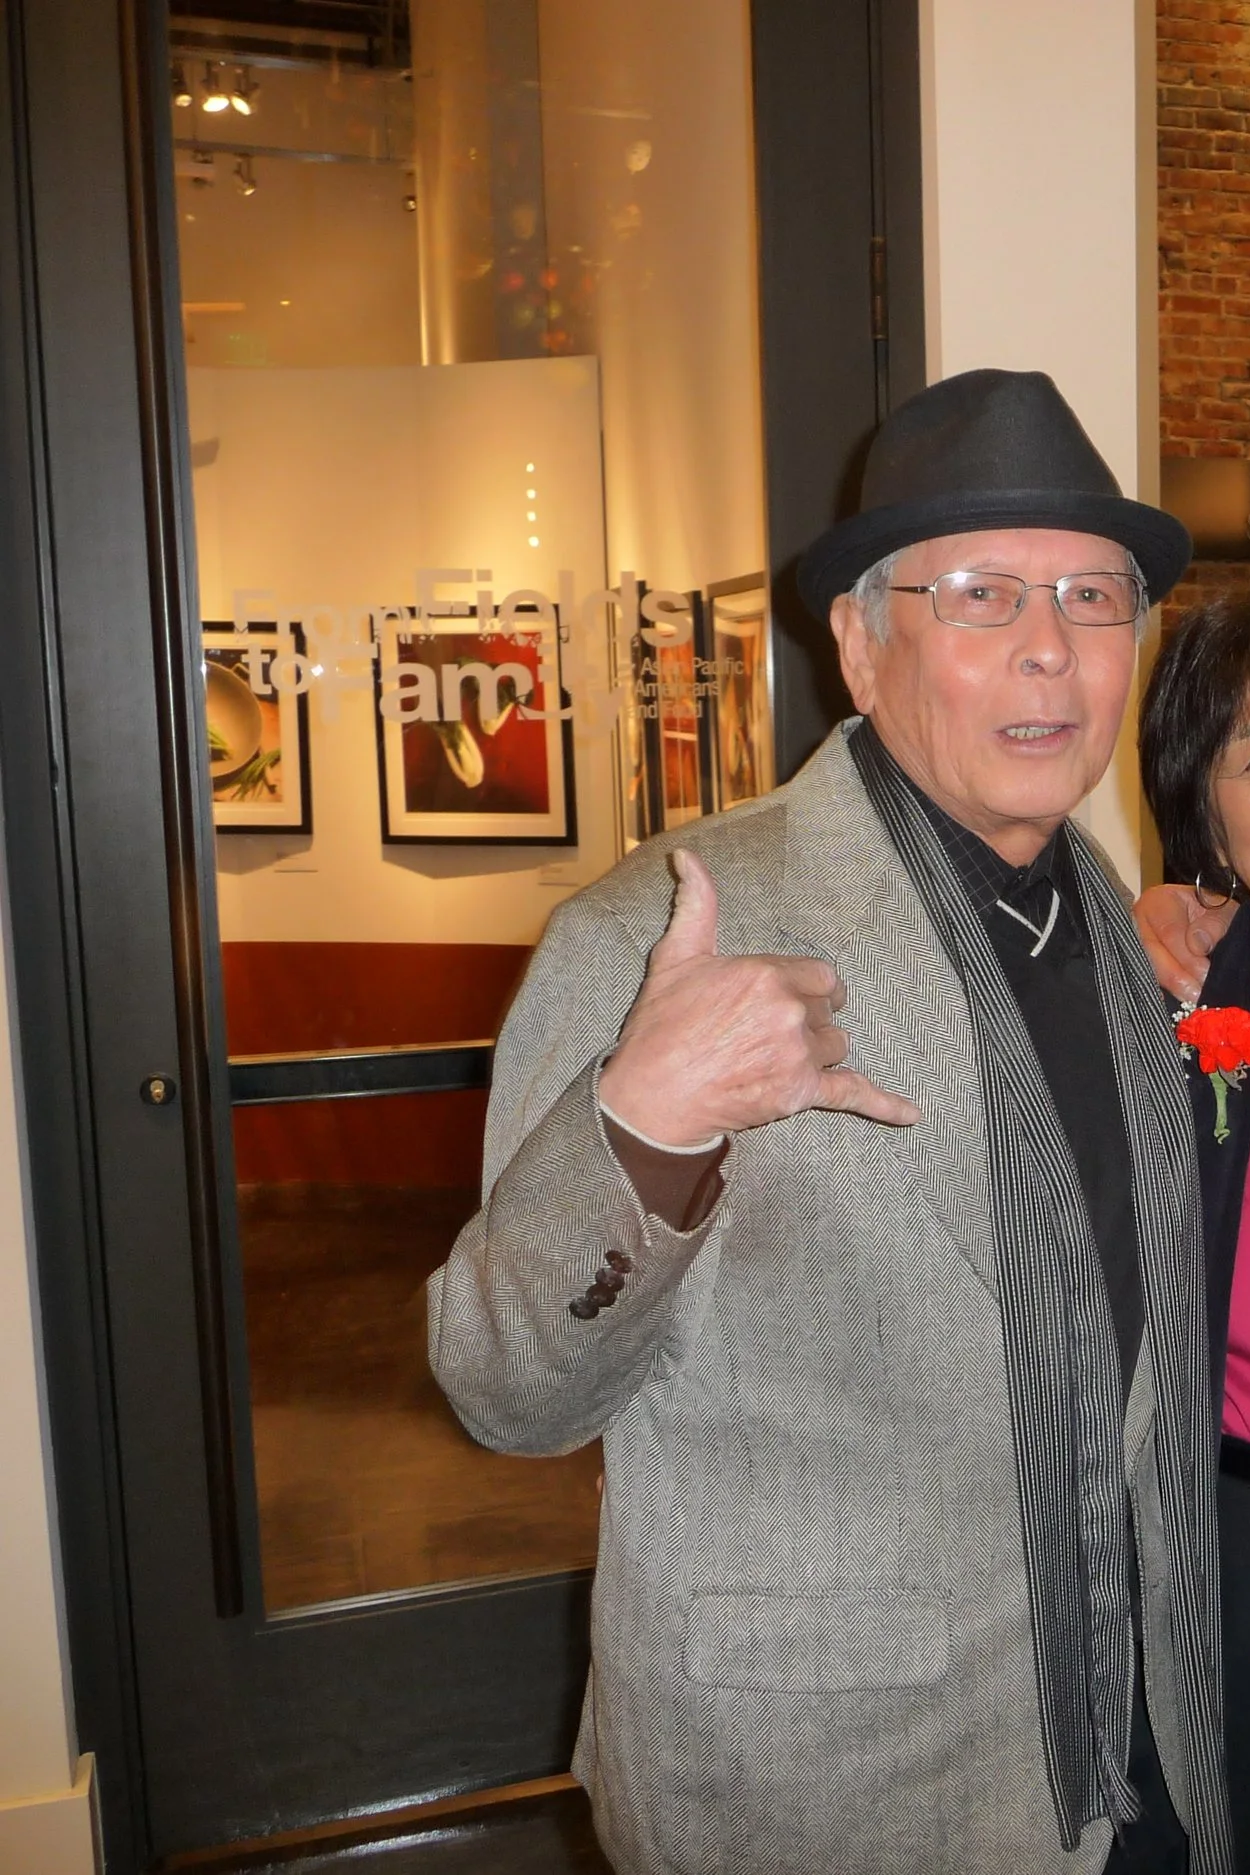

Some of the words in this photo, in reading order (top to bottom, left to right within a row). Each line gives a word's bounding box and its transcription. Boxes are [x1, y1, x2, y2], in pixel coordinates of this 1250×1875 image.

[233, 588, 404, 645] From
[417, 569, 694, 648] Fields
[241, 643, 313, 696] to
